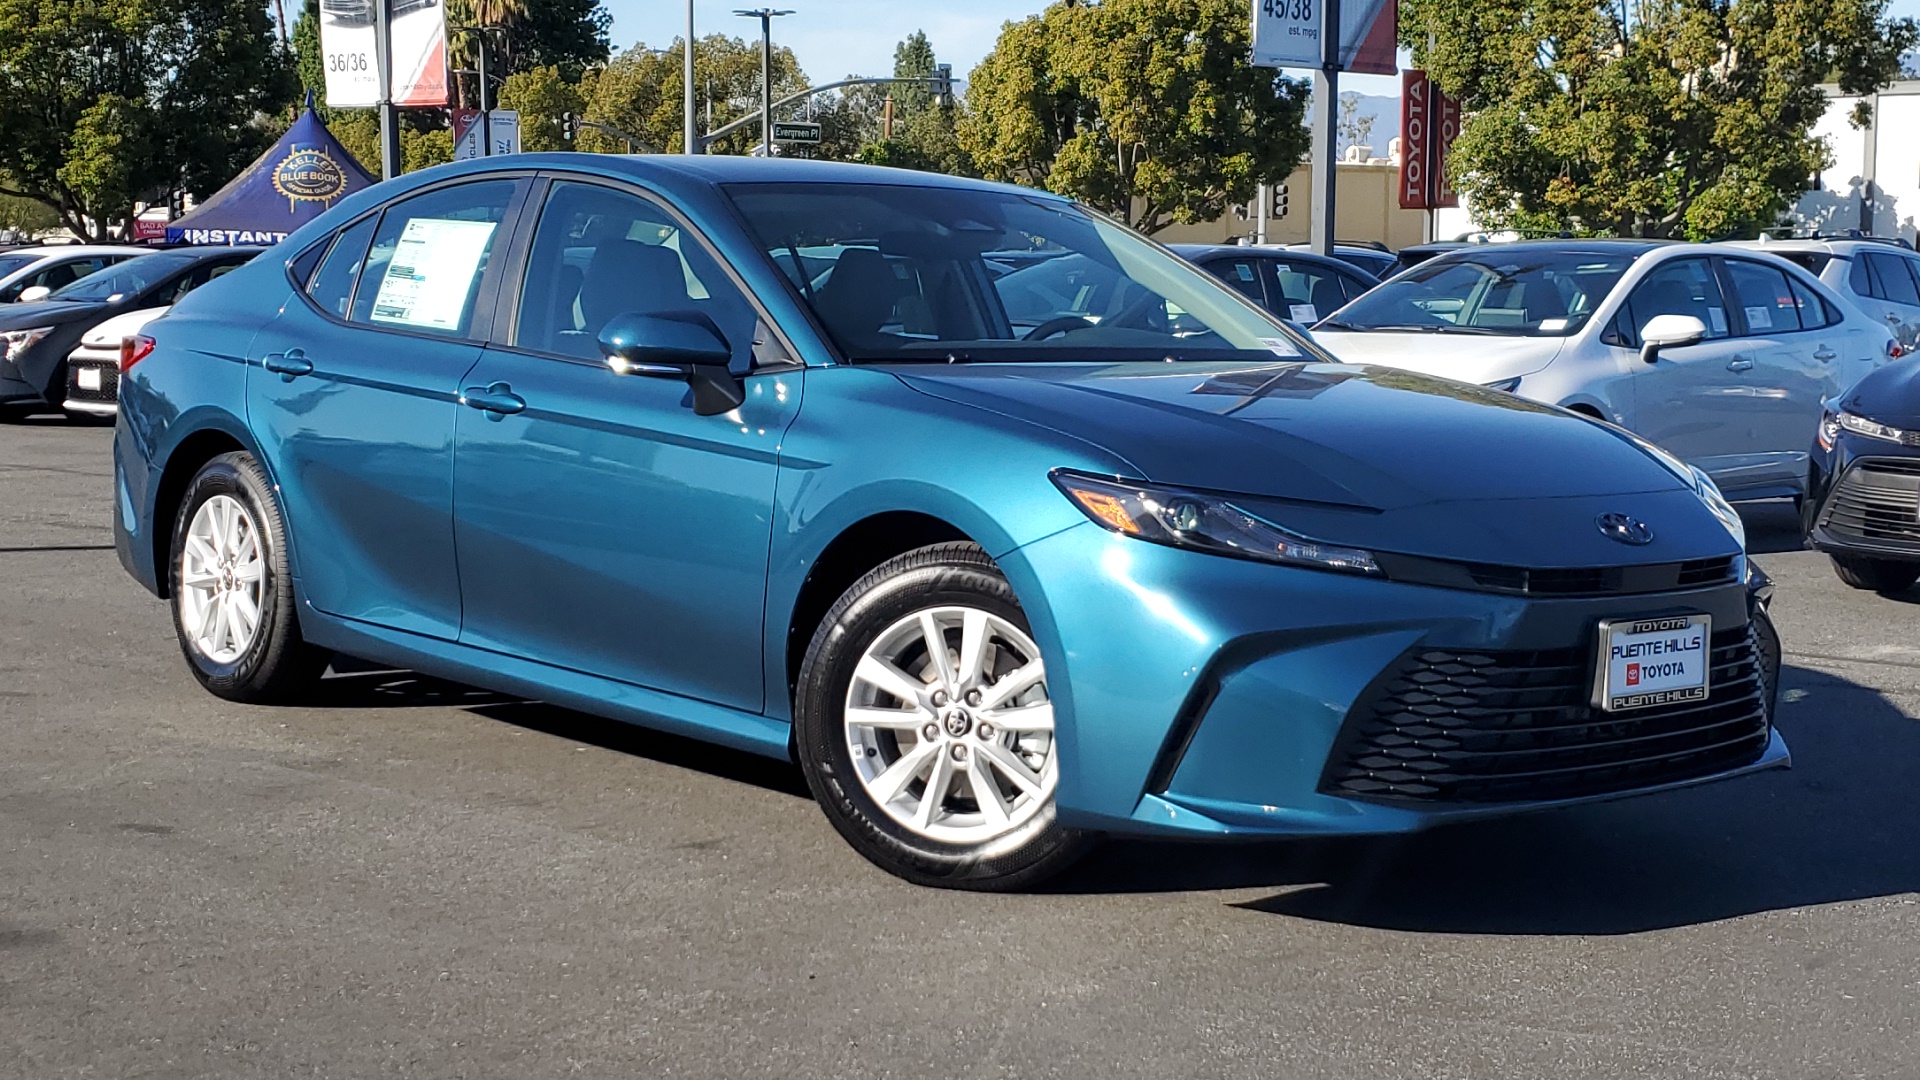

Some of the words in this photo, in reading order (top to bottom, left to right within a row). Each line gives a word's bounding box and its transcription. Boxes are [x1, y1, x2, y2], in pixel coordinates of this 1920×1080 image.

[1262, 0, 1313, 21] 45/38
[1302, 26, 1317, 39] mpg
[328, 53, 367, 72] 36/36
[776, 127, 809, 139] Evergreen
[1406, 81, 1422, 201] TOYOTA
[287, 155, 335, 171] KELLEY
[280, 171, 308, 182] BLUE
[309, 171, 339, 183] BOOK
[184, 229, 288, 244] INSTANT
[1635, 620, 1686, 632] TOYOTA
[1611, 640, 1662, 660] PUENTE
[1664, 637, 1701, 653] HILLS
[1642, 662, 1684, 679] TOYOTA
[1613, 693, 1665, 709] PUENTE
[1666, 687, 1703, 702] HILLS
